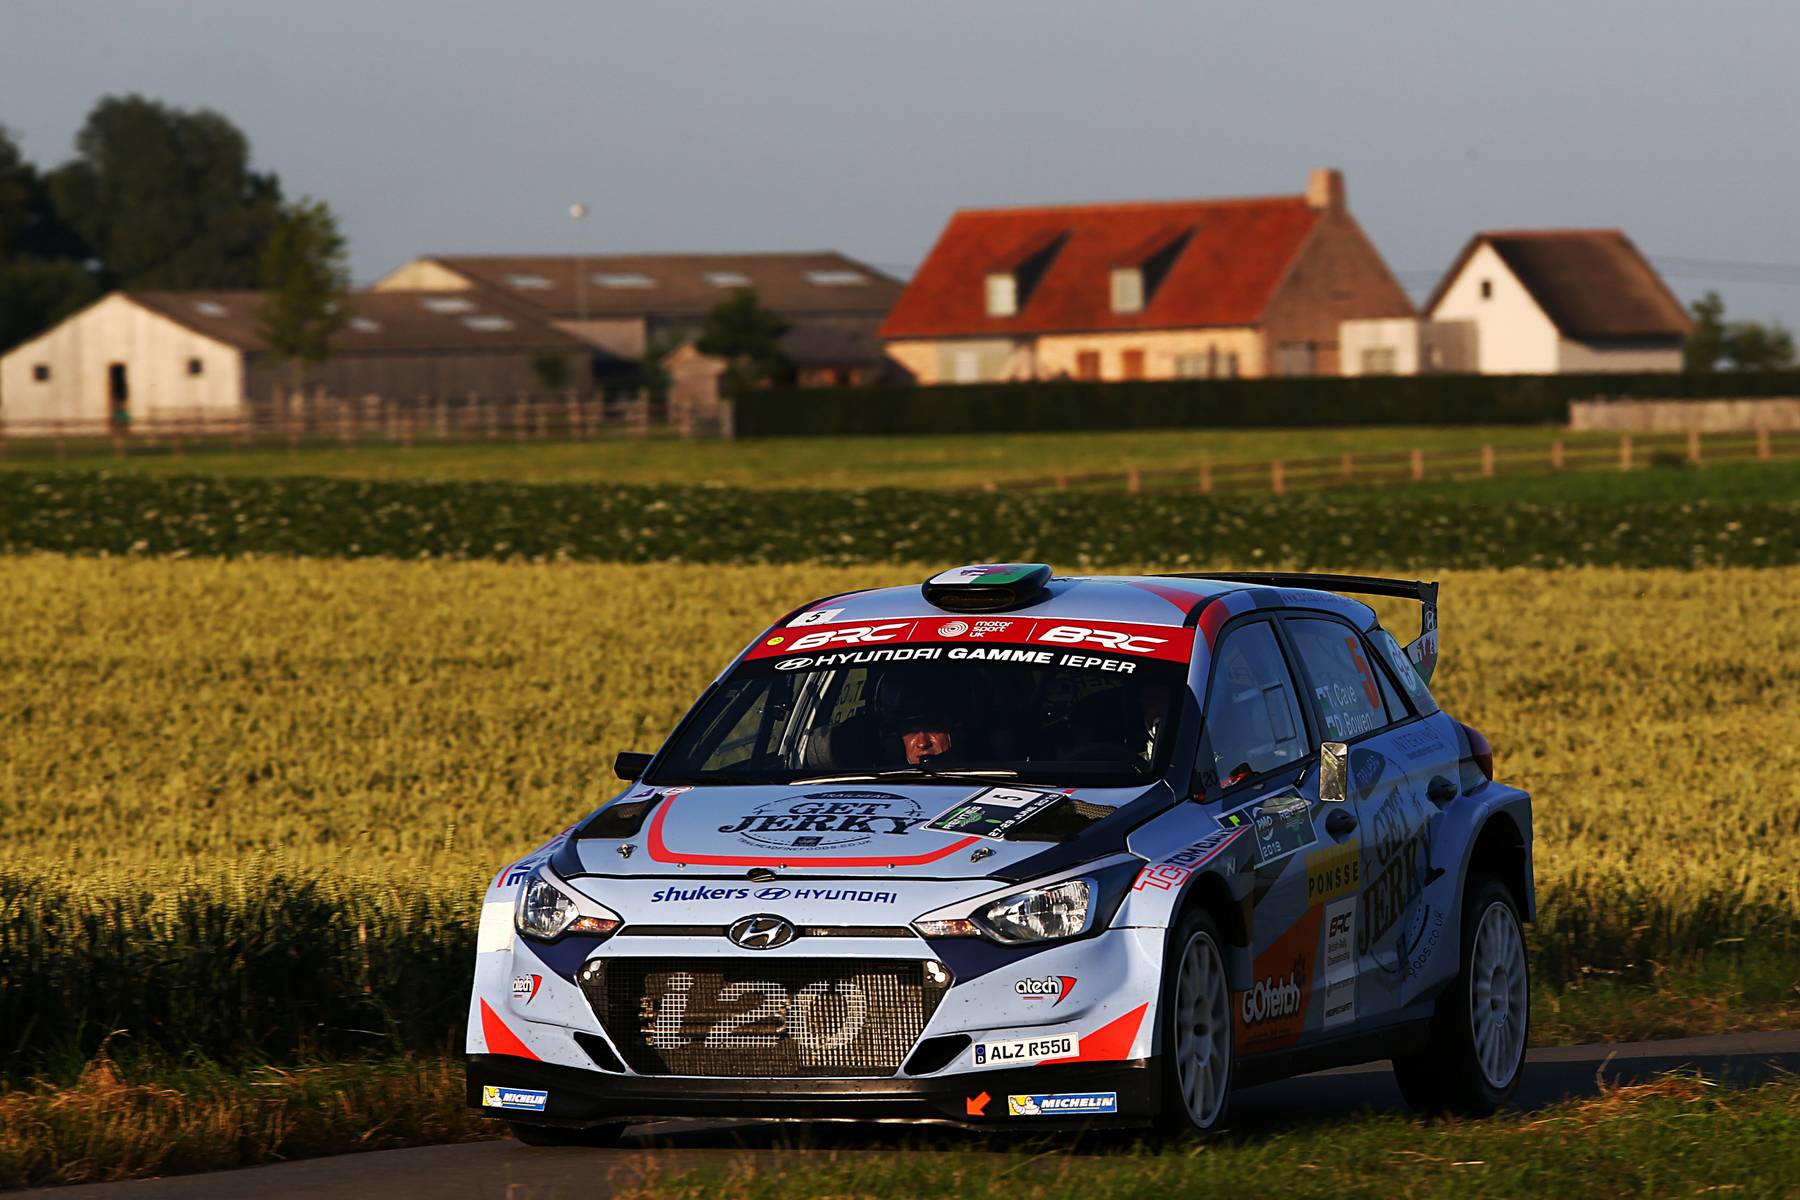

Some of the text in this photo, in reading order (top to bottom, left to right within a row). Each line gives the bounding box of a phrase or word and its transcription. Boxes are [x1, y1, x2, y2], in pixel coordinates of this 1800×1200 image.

[805, 611, 826, 623] 5
[785, 622, 911, 652] BRC
[1038, 625, 1168, 653] BRC
[815, 647, 1137, 674] HYUNDAI GAMME IEPER
[1334, 683, 1358, 706] Cave
[1343, 712, 1373, 735] Bowen
[788, 803, 891, 815] GET
[718, 815, 930, 835] JERKY
[1308, 862, 1360, 899] PONSSE
[651, 886, 898, 904] shukers HYUNDAI
[1328, 912, 1352, 937] BRC
[1015, 976, 1059, 994] atech
[991, 1038, 1071, 1060] ALZ R550
[503, 1092, 546, 1104] MICHELIN
[1041, 1097, 1113, 1108] MICHELIN
